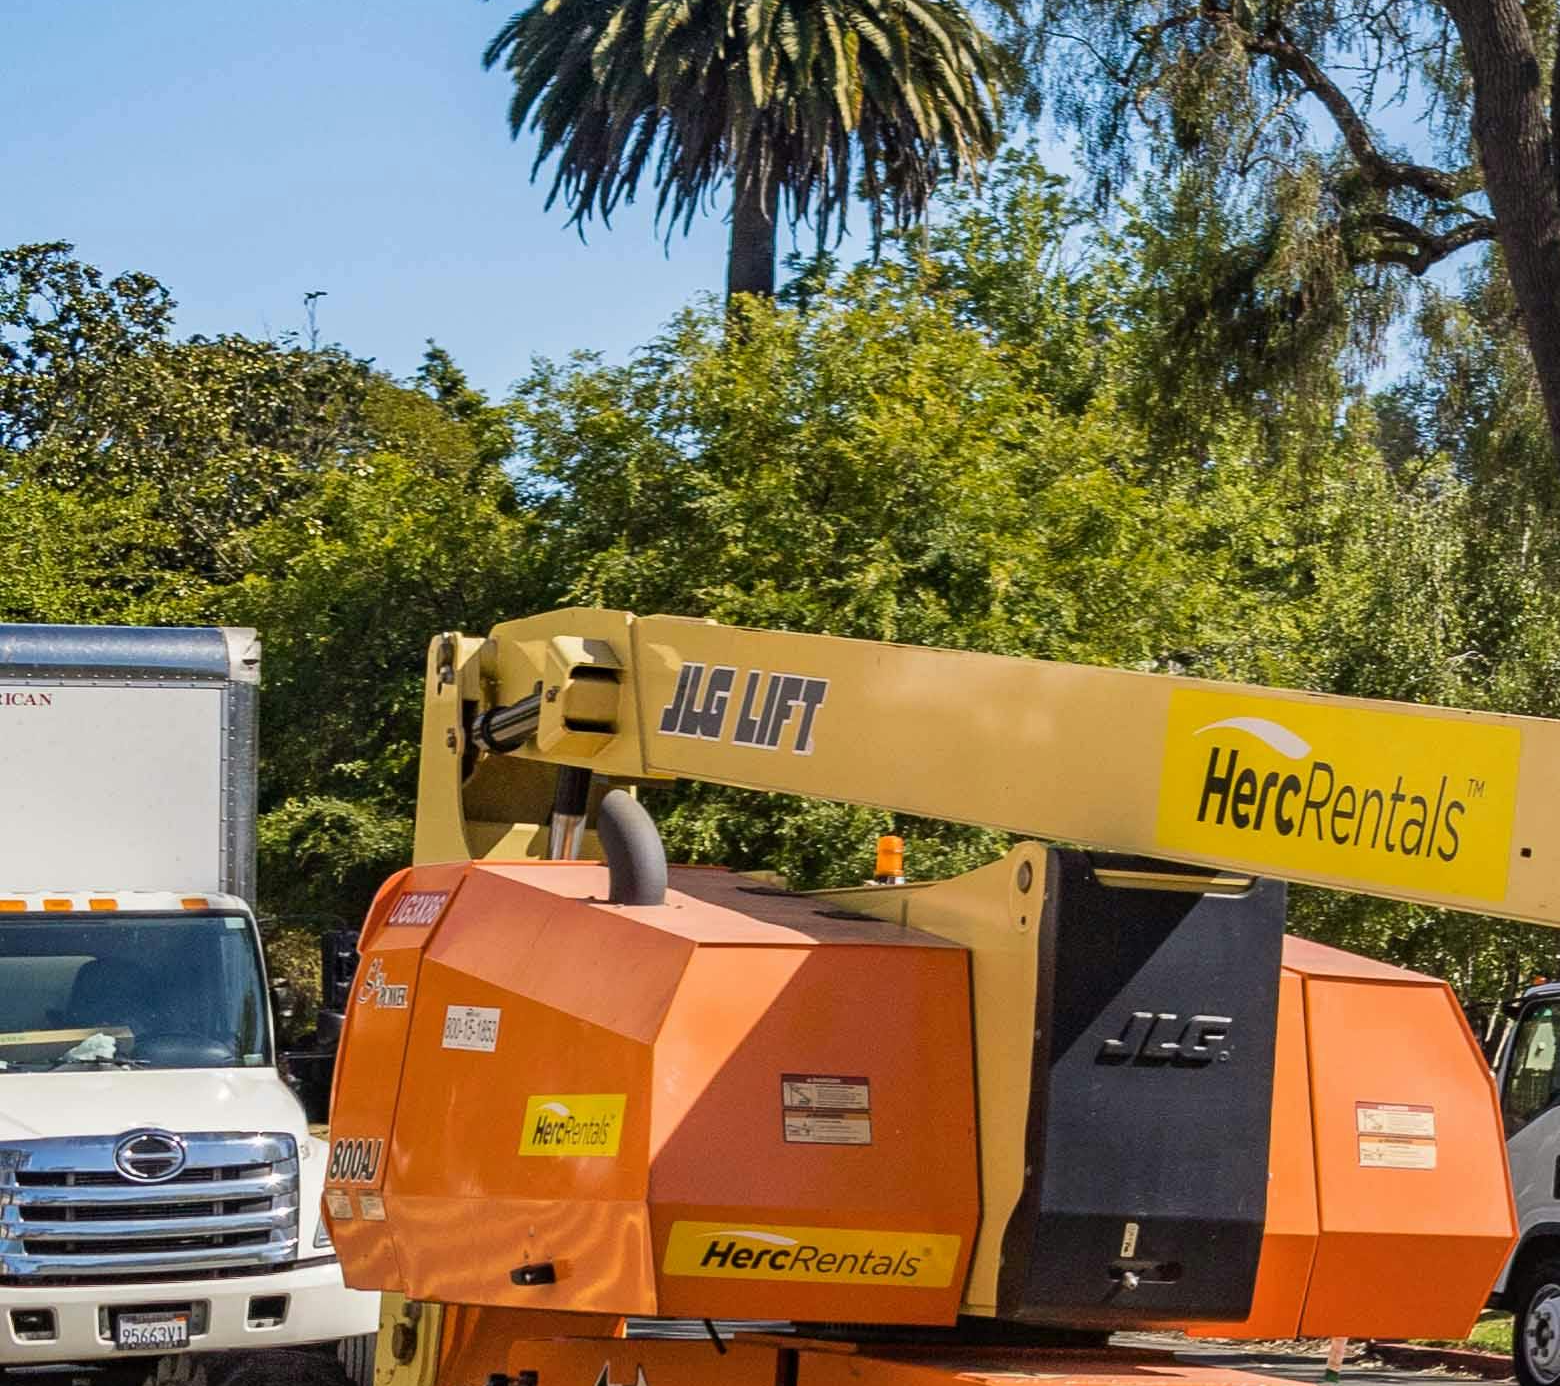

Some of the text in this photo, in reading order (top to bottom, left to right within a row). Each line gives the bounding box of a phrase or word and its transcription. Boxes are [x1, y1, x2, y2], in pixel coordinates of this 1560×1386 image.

[0, 693, 53, 706] ICAN
[658, 662, 830, 756] JLG LIFT
[1197, 747, 1465, 862] HercRentals
[1094, 1012, 1232, 1068] JLG
[532, 1116, 615, 1147] HercRentals
[329, 1139, 383, 1181] 800AJ
[700, 1240, 921, 1277] HercRentals
[122, 1325, 183, 1343] 95663V1
